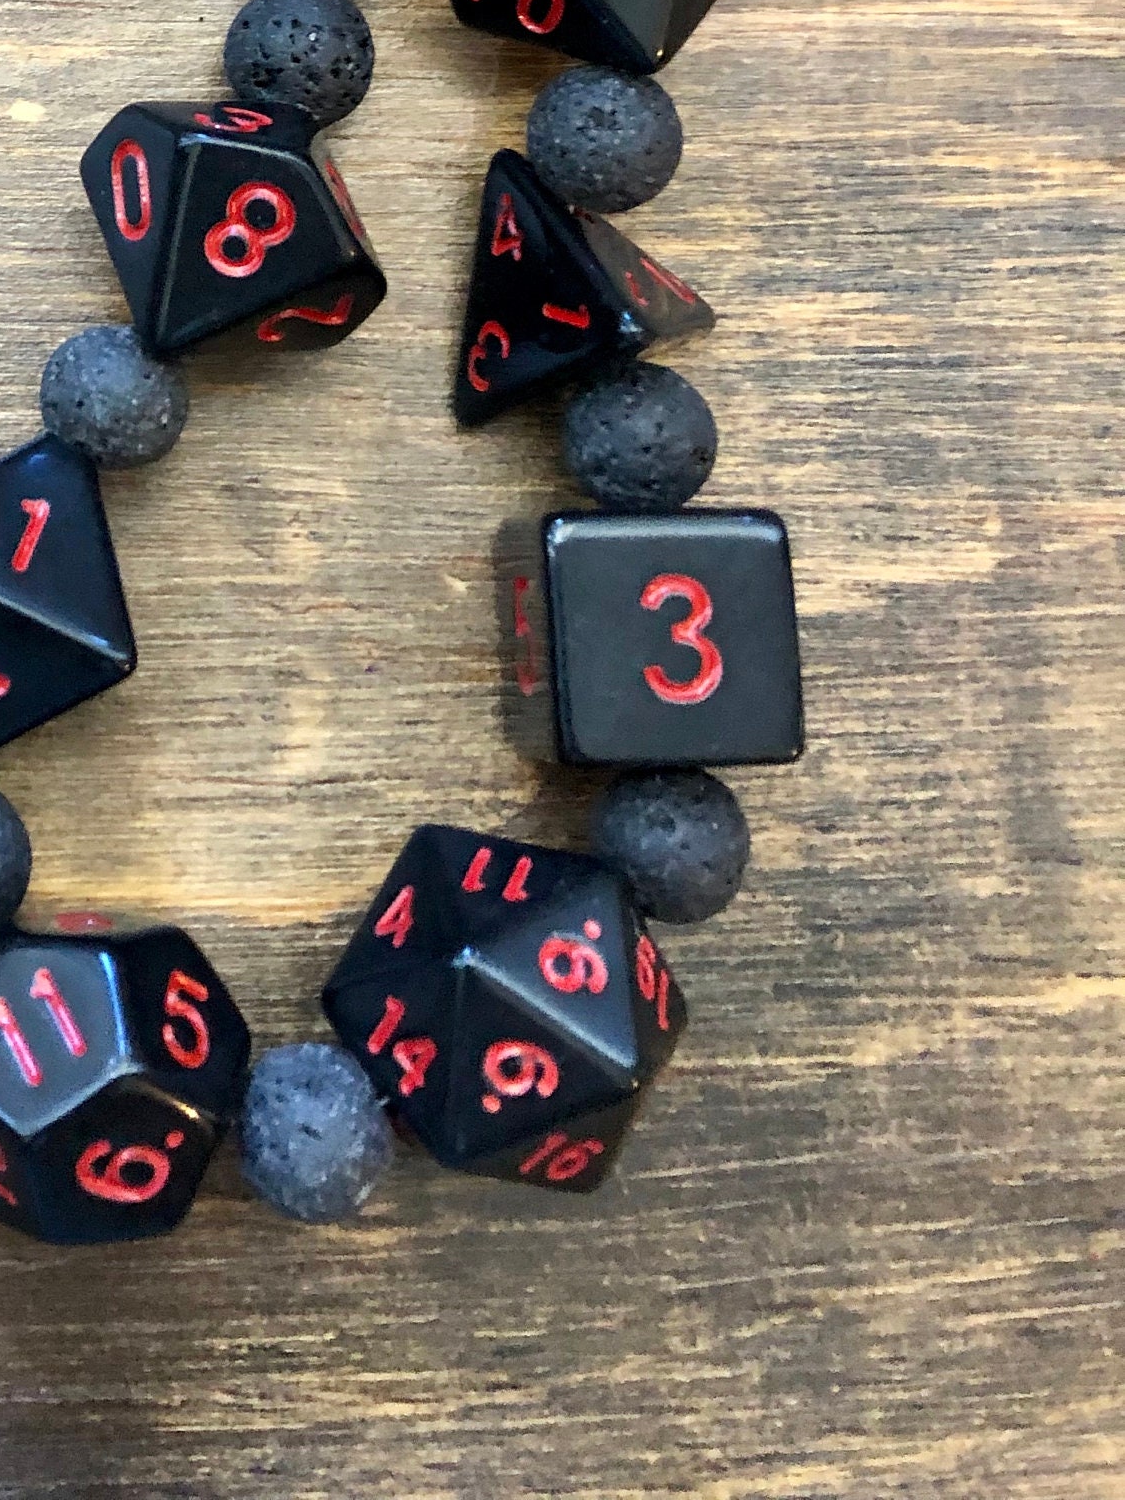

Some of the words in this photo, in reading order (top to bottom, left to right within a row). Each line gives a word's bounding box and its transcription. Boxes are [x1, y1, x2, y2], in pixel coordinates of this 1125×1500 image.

[111, 138, 152, 242] 0
[490, 192, 523, 261] 4
[203, 180, 297, 278] 8
[541, 302, 591, 330] 1
[466, 319, 511, 393] 3
[11, 498, 51, 574] 1
[639, 572, 724, 705] 3
[461, 846, 534, 903] 11
[374, 884, 415, 948] 4
[161, 968, 210, 1069] 5
[366, 994, 438, 1097] 14
